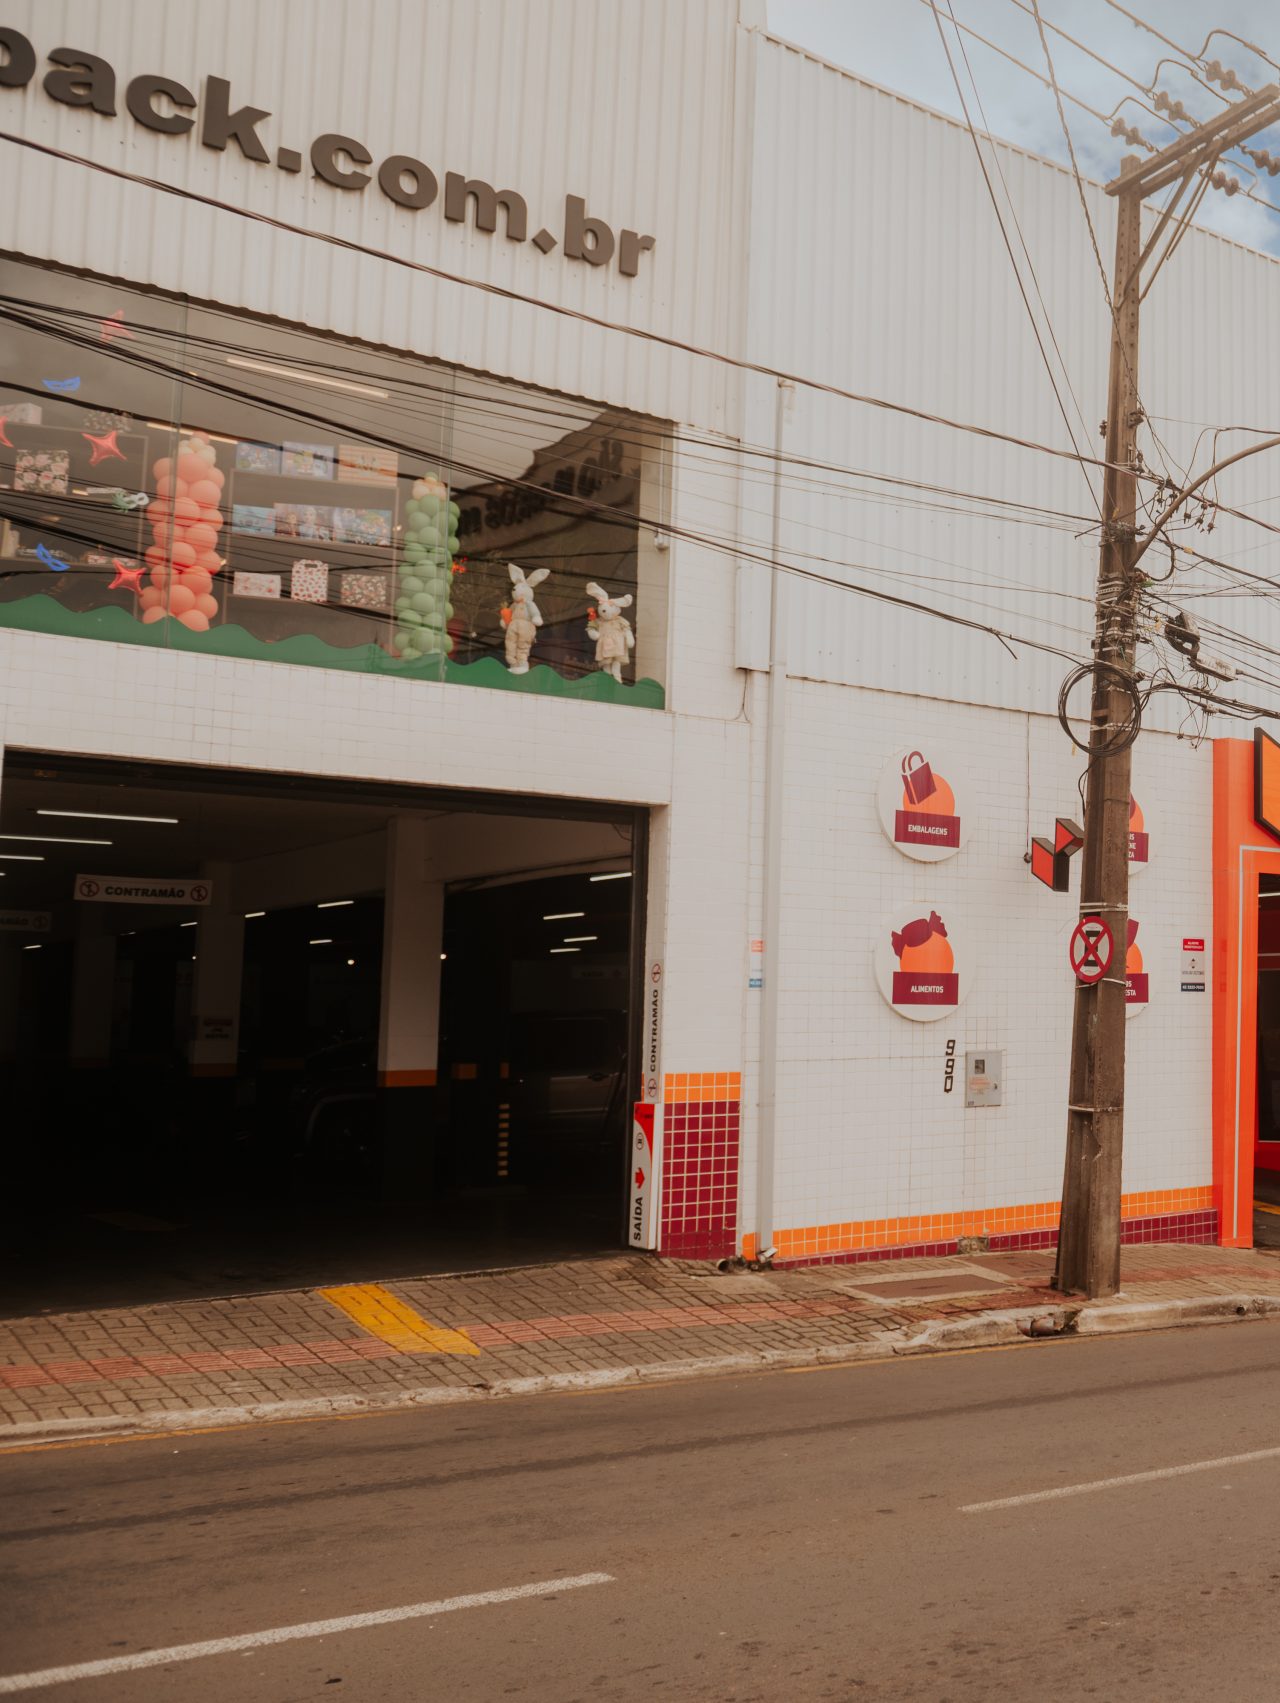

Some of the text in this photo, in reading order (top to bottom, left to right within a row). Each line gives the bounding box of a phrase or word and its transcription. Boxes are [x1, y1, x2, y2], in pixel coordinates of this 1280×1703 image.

[908, 824, 948, 836] EMBALAGENS
[104, 885, 185, 898] CONTRAMÃO
[910, 985, 944, 994] ALIMENTOS
[633, 1196, 643, 1241] SAÍDA
